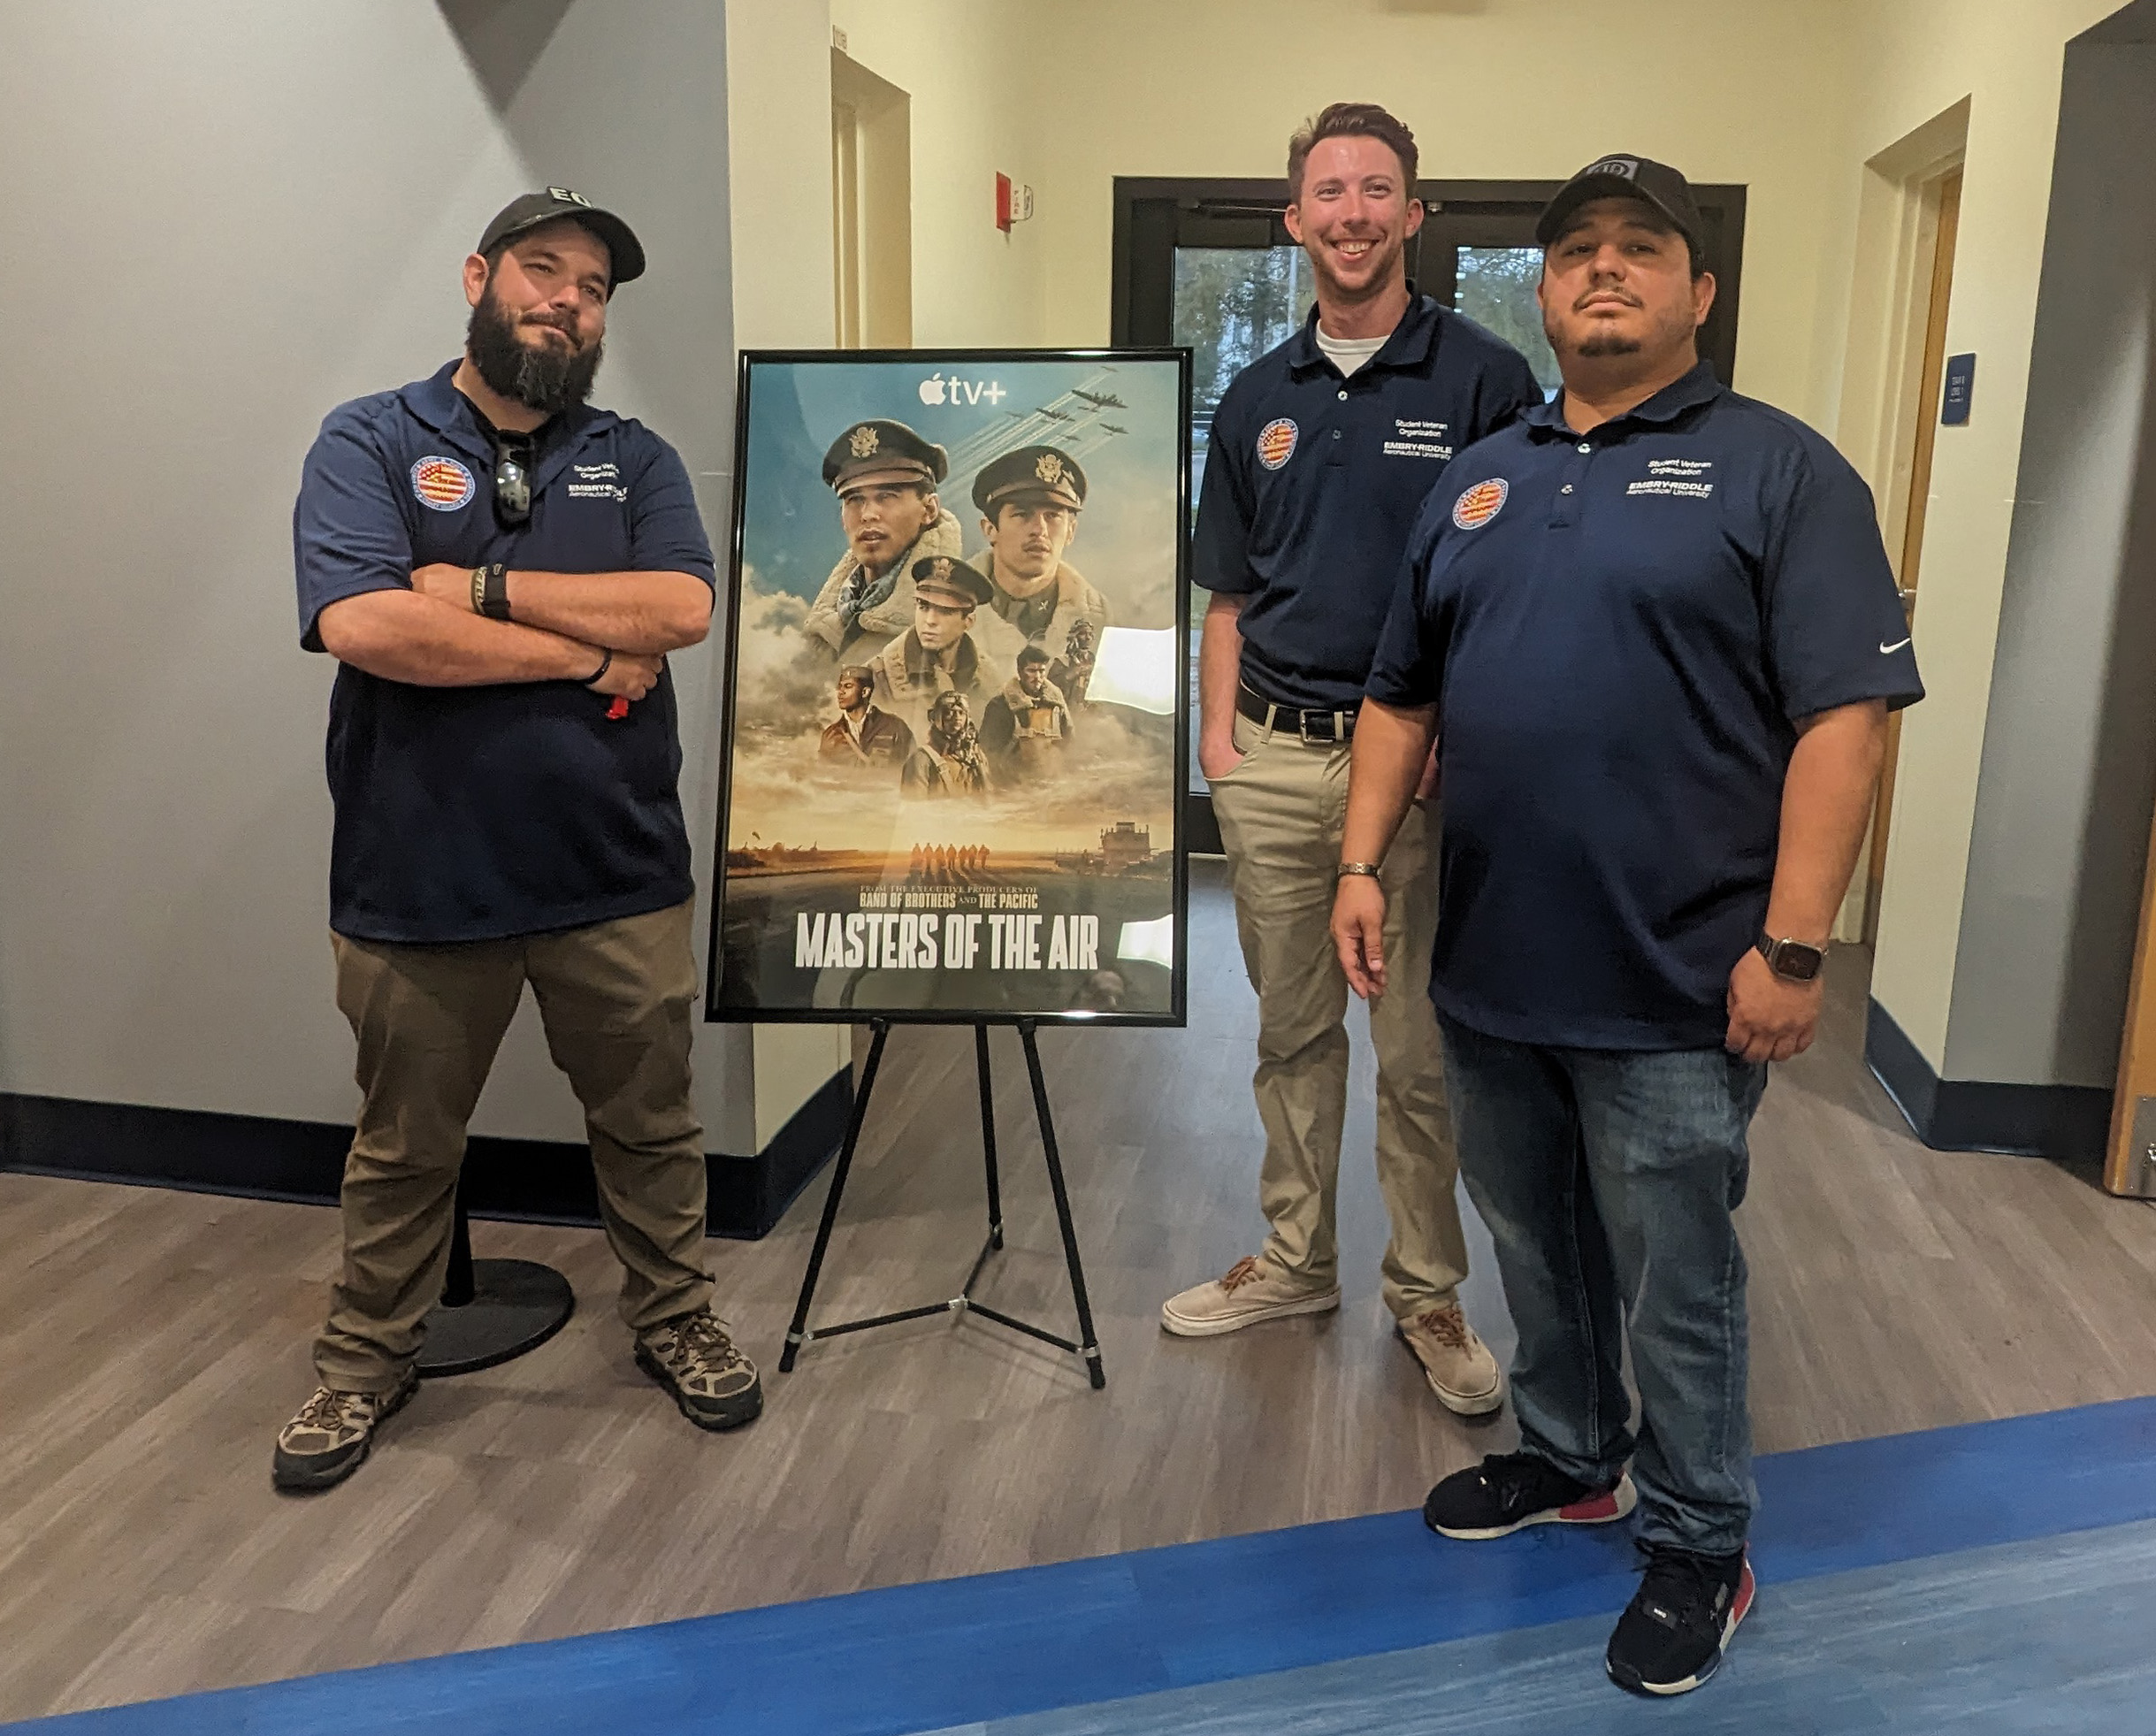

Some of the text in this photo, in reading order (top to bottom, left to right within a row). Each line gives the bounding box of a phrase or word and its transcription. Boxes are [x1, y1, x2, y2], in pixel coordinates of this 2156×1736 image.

[1395, 418, 1449, 430] Student Veteran
[1398, 428, 1442, 438] Organization
[1384, 441, 1453, 455] EMBRY-RIDDLE
[1680, 460, 1712, 469] Veteran
[1650, 466, 1702, 476] Organization
[1629, 480, 1714, 492] EMBRY-RIDDLE
[967, 885, 1023, 894] PRODUCERS
[860, 892, 1039, 909] BAND OF BROTHERS AND THE PACIFIC
[795, 912, 1099, 970] MASTERS OF THE AIR
